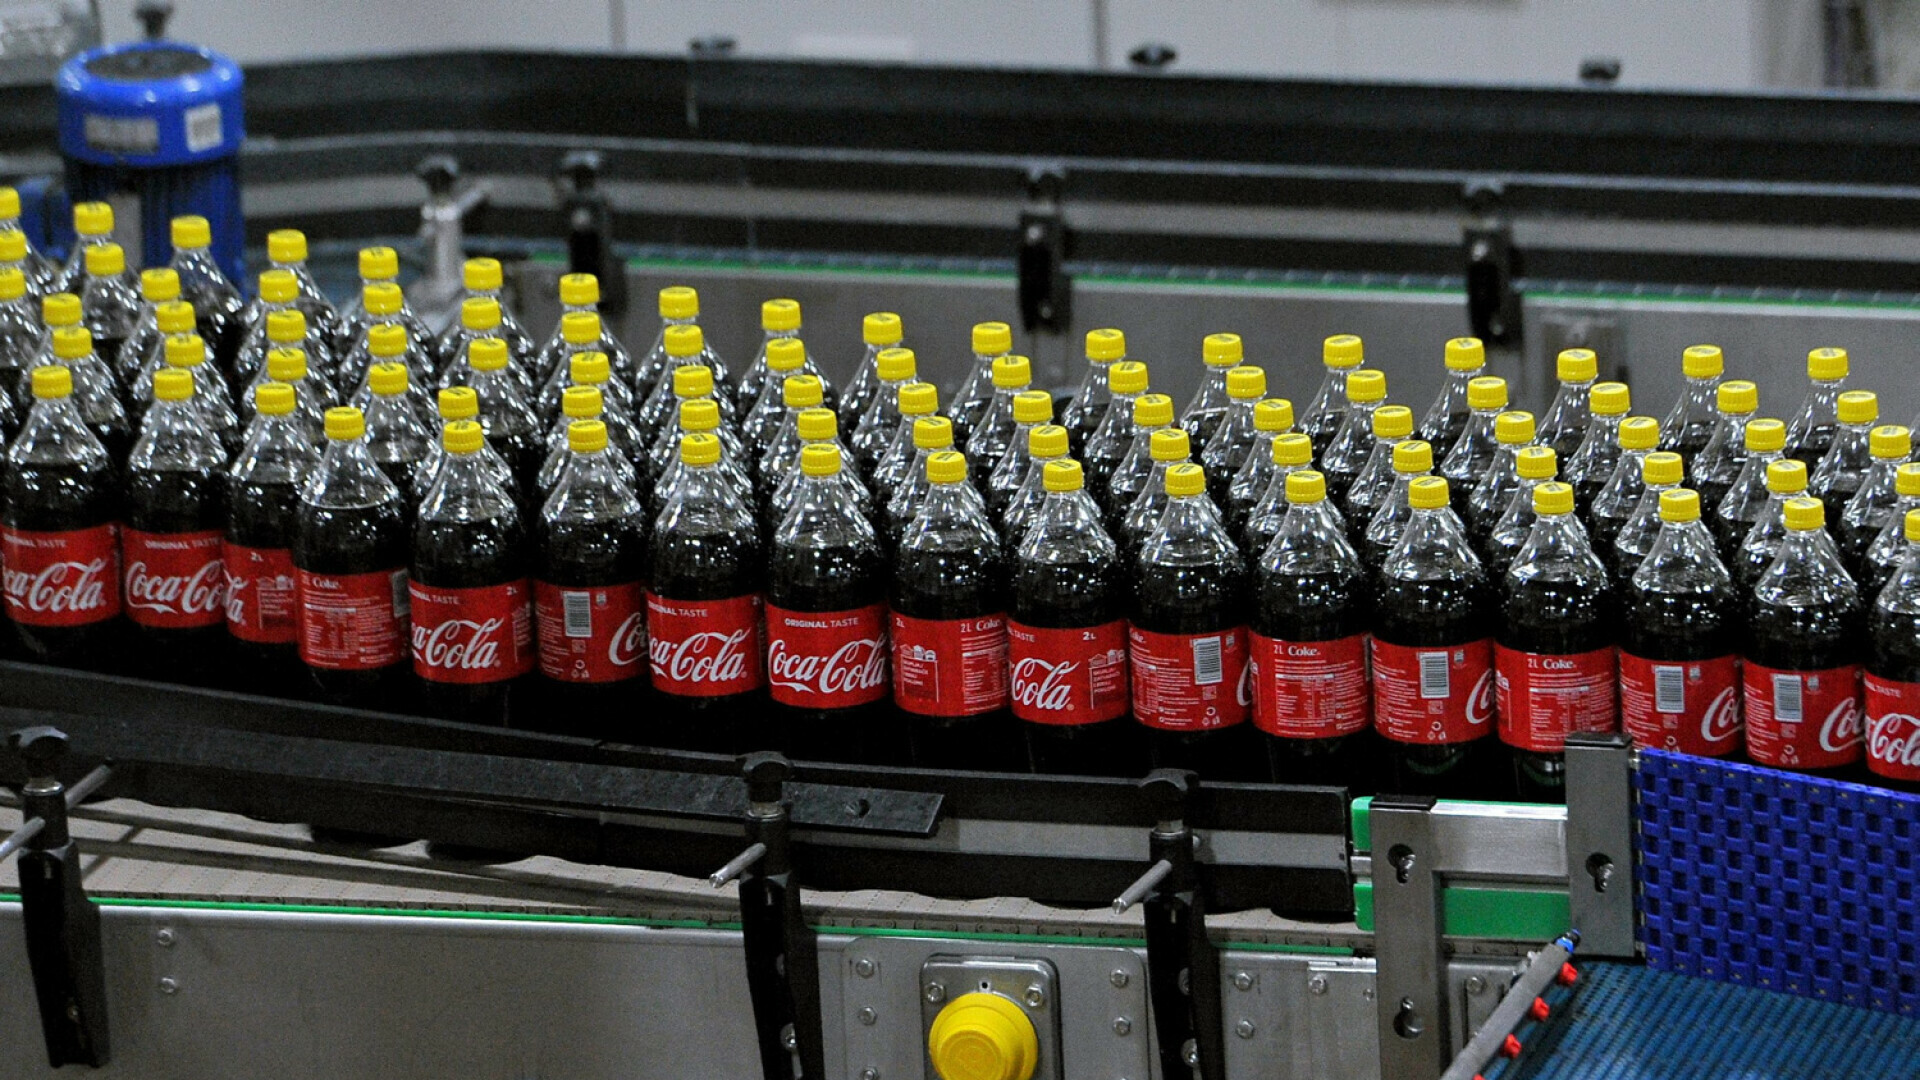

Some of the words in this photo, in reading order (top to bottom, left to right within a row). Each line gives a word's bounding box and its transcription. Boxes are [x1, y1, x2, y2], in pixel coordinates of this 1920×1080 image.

[678, 608, 708, 618] TASTE
[784, 617, 829, 629] ORIGINAL
[829, 617, 859, 629] TASTE
[1082, 631, 1097, 641] 2L
[1287, 645, 1319, 656] Coke
[768, 632, 887, 695] Coca-Cola
[1542, 658, 1575, 670] Coke
